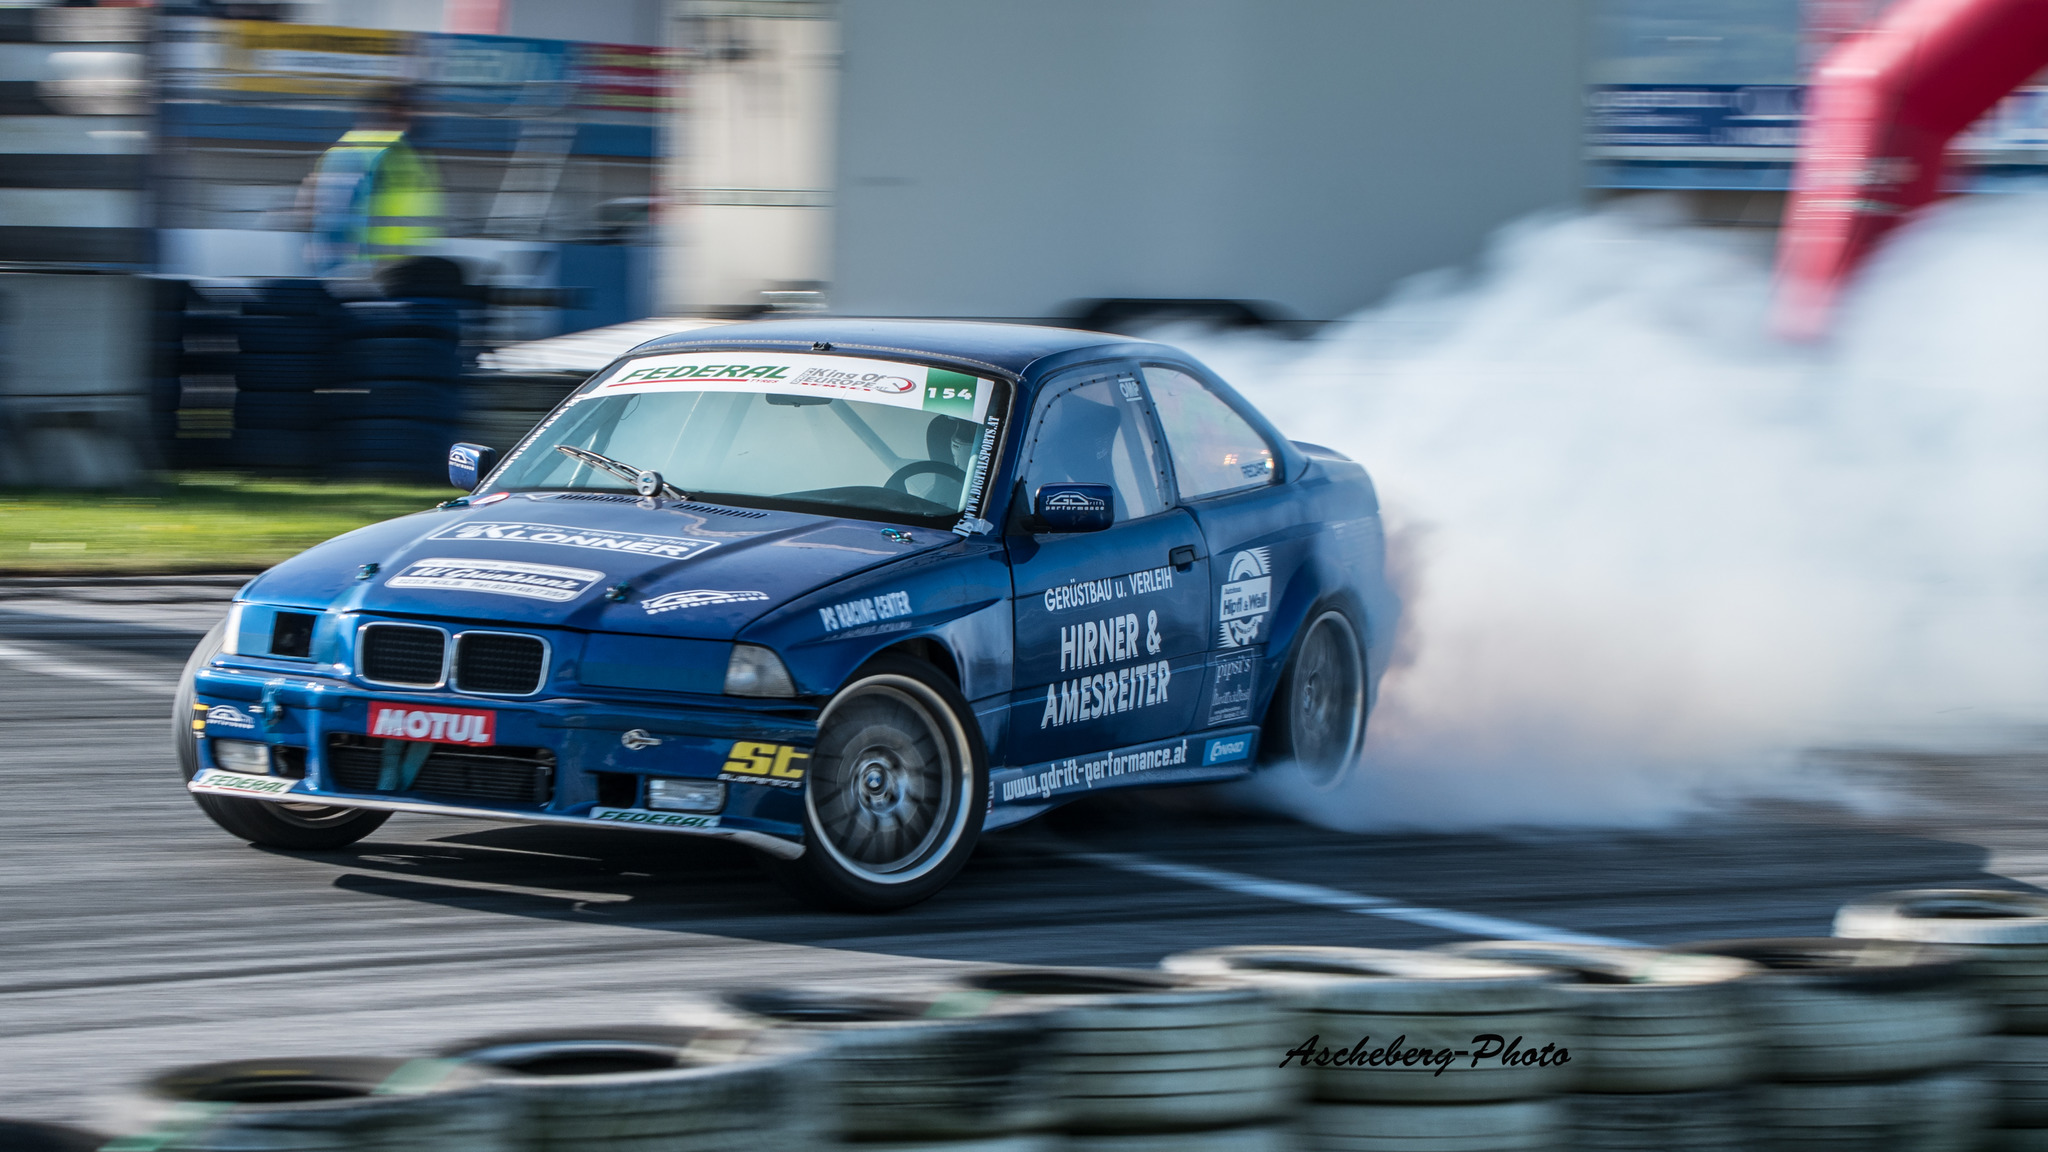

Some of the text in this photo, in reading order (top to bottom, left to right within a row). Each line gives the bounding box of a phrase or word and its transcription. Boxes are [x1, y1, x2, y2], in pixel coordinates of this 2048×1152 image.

[618, 364, 792, 383] FEDERAL
[803, 377, 877, 388] EUROPE
[927, 387, 973, 400] 154
[1119, 381, 1140, 398] OMP
[642, 537, 700, 547] Technik
[1045, 578, 1112, 612] GERÜSTBAU
[1129, 567, 1174, 596] VERLEIH
[819, 606, 840, 632] PS
[874, 590, 913, 619] CENTER
[1060, 609, 1162, 673] HIRNER &
[1041, 660, 1172, 730] AMESREITER
[373, 708, 491, 743] MOTUL
[1003, 739, 1188, 801] www.gdrift-performance.at
[203, 774, 287, 793] FEDERAL
[597, 810, 714, 828] FEDERAL
